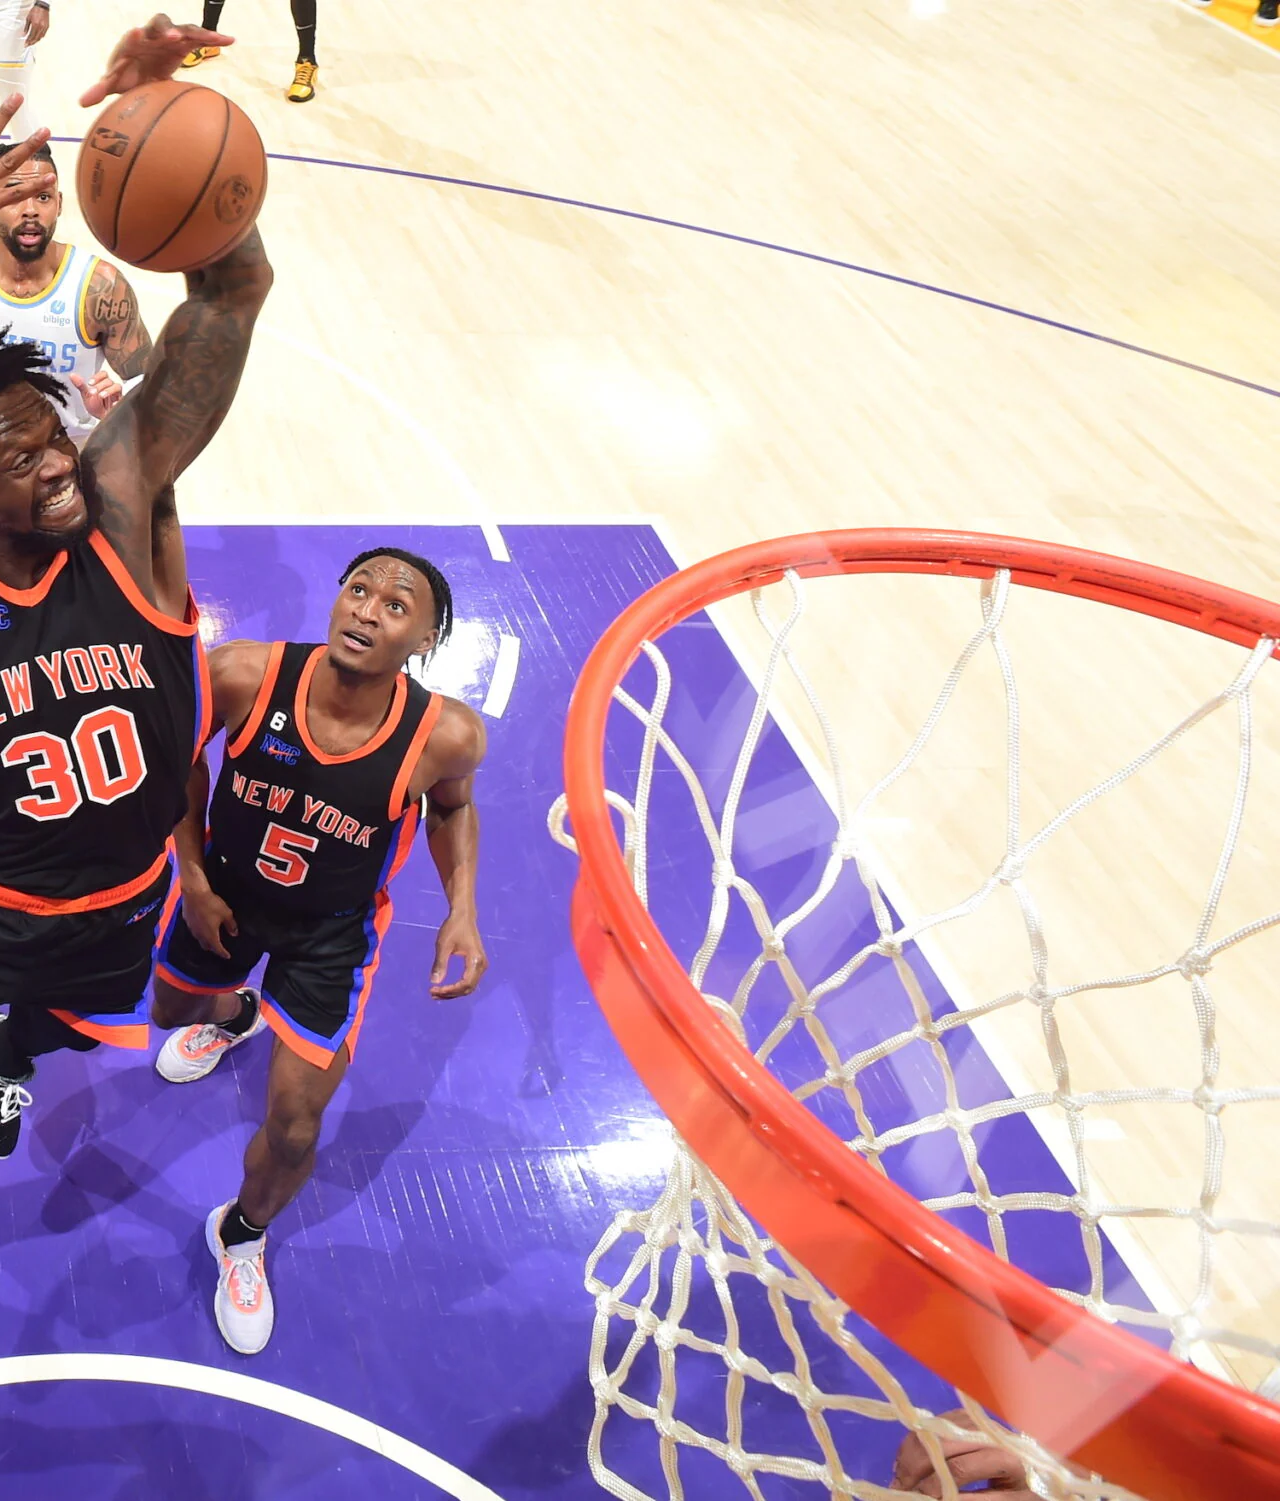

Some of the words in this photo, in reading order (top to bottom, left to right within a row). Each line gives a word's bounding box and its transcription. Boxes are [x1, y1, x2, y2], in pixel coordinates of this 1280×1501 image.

[43, 315, 71, 326] bibigo
[35, 643, 155, 700] YORK
[260, 732, 301, 767] NYC
[270, 711, 288, 732] 6
[0, 705, 148, 822] 30
[232, 770, 294, 814] NEW
[301, 794, 380, 849] YORK
[255, 821, 319, 887] 5
